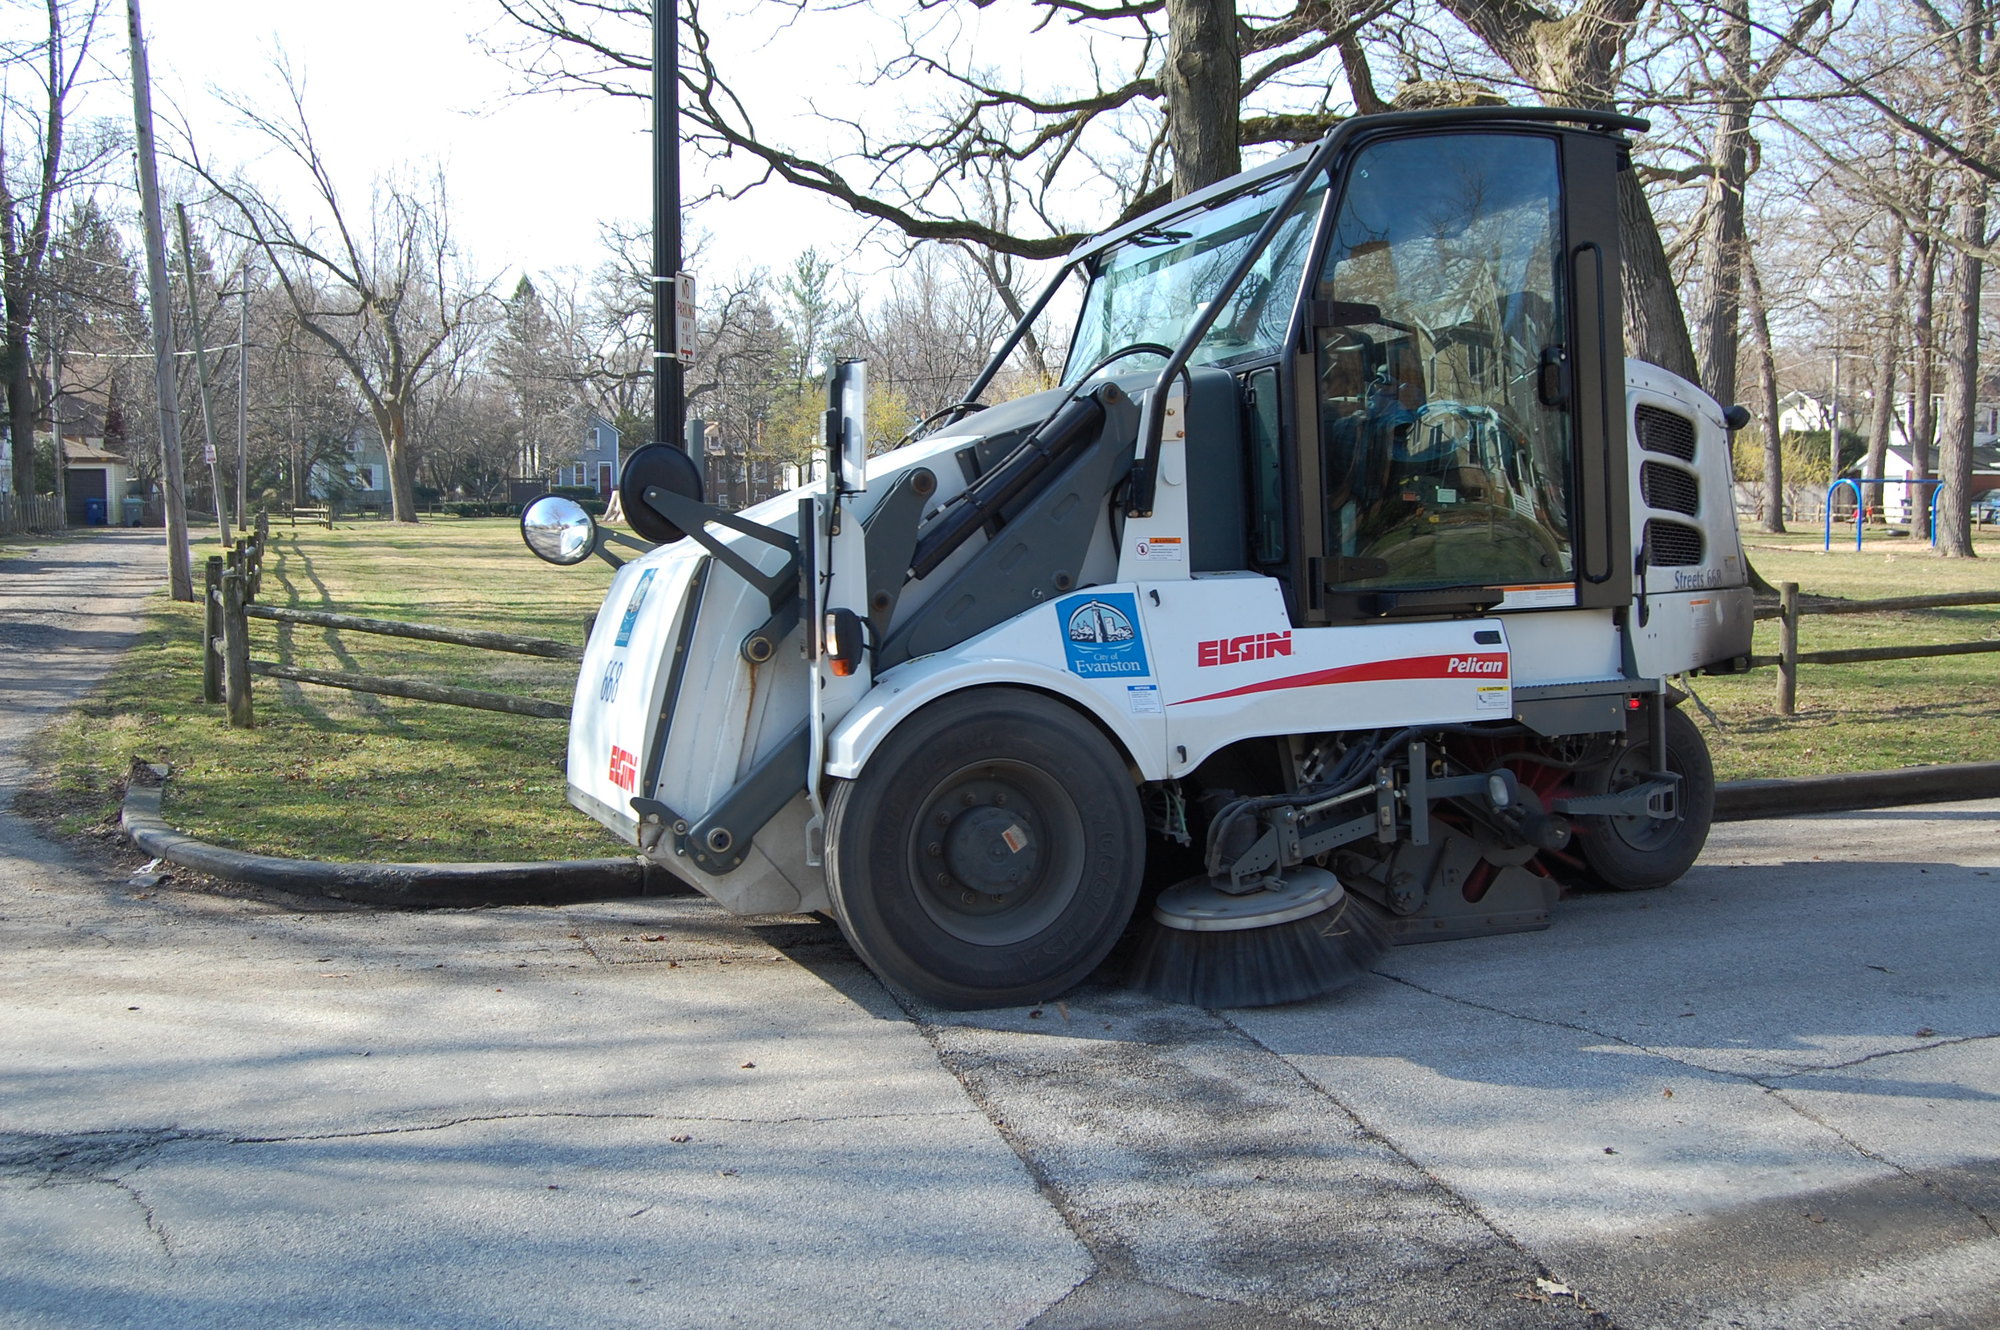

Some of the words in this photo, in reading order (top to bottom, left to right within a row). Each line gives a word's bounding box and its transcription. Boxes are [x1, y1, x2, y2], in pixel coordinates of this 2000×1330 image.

[681, 282, 690, 299] NO
[682, 321, 691, 331] ANY
[1674, 570, 1704, 589] Streets
[1707, 568, 1722, 586] 668
[1093, 653, 1109, 662] City
[1111, 652, 1118, 660] of
[1198, 630, 1292, 667] ELGIN
[1075, 659, 1141, 673] Evanston
[1447, 657, 1503, 673] Pelican
[600, 660, 624, 703] 668
[608, 745, 638, 794] ELGIN
